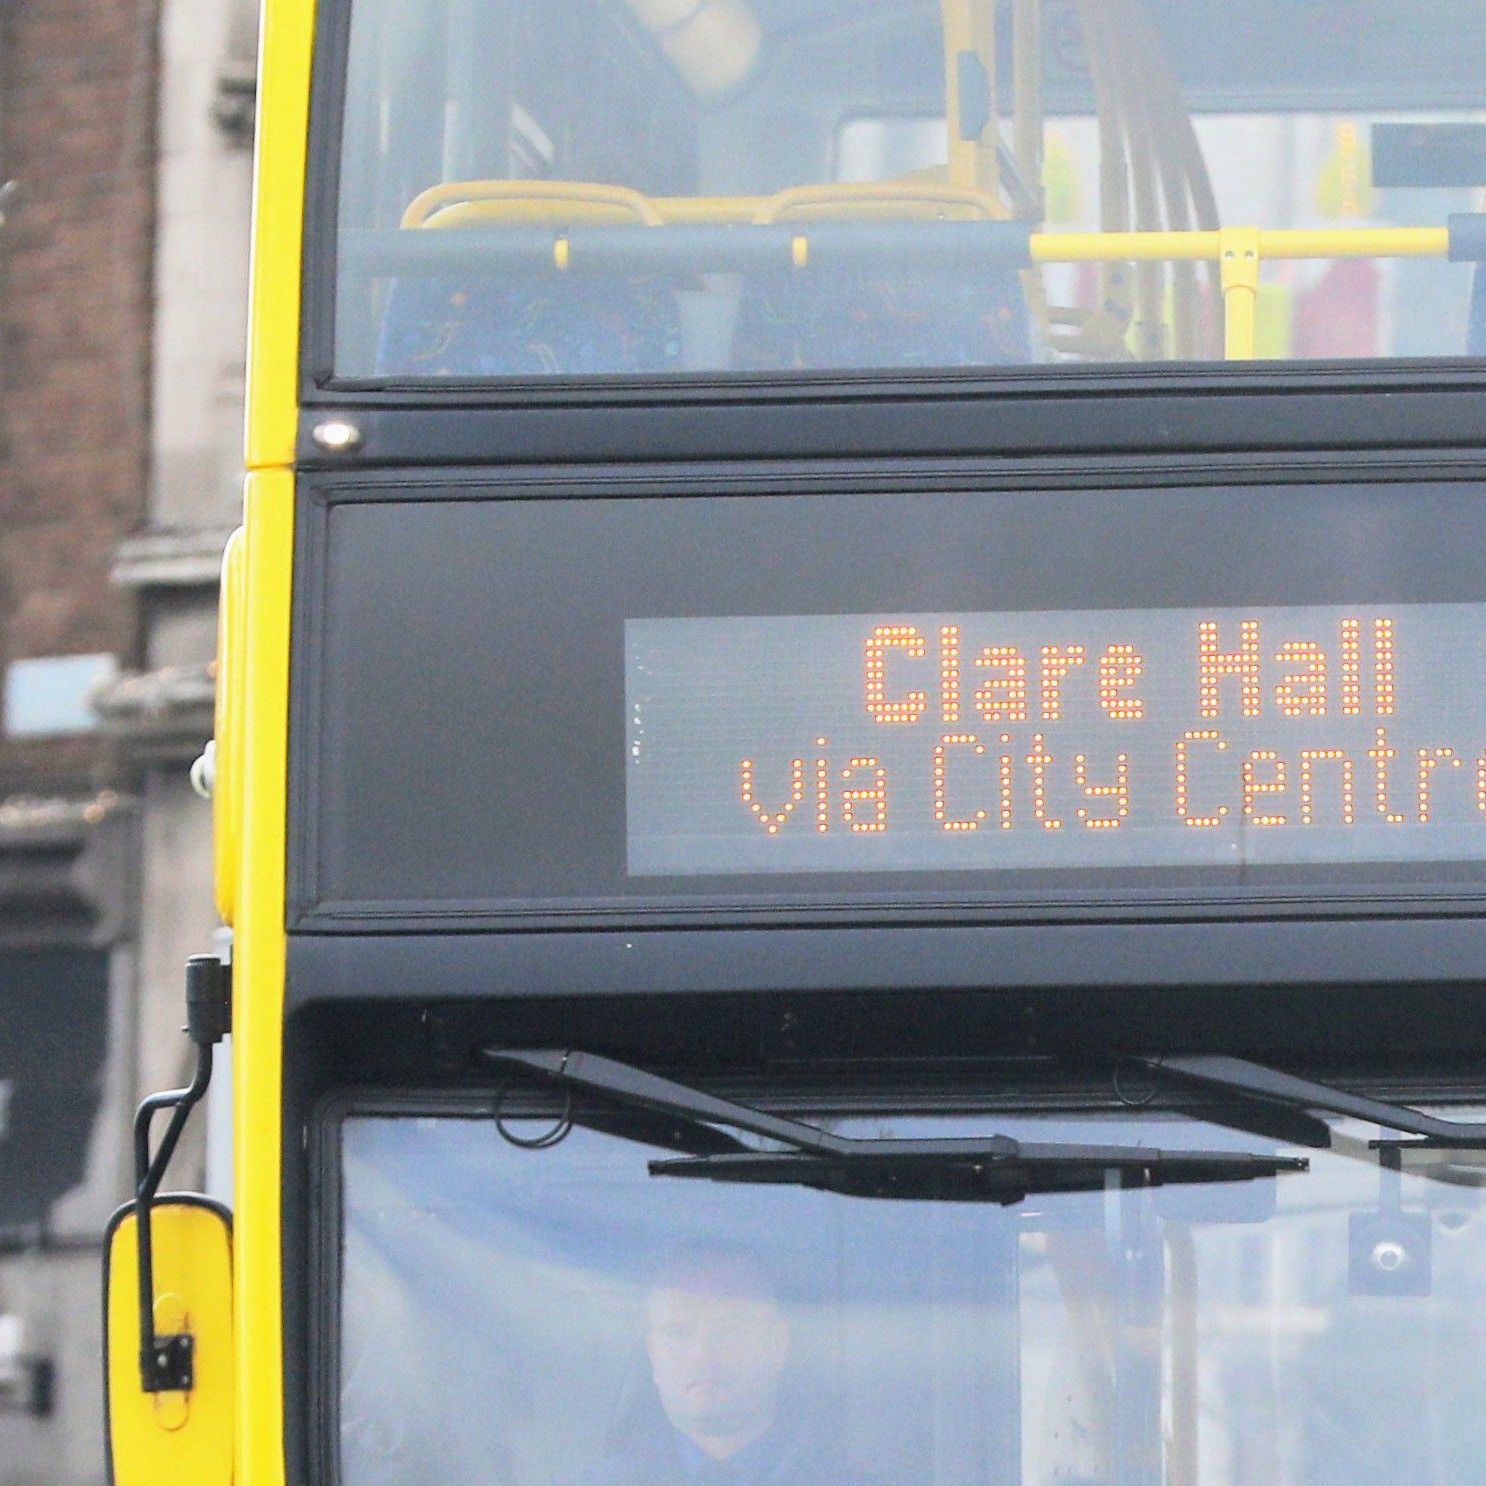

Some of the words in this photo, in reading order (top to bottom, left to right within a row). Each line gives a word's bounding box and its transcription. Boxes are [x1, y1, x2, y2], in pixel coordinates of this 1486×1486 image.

[864, 624, 1145, 724] Clare
[1197, 616, 1395, 718] Hall
[739, 736, 887, 834] via
[932, 730, 1130, 828] City
